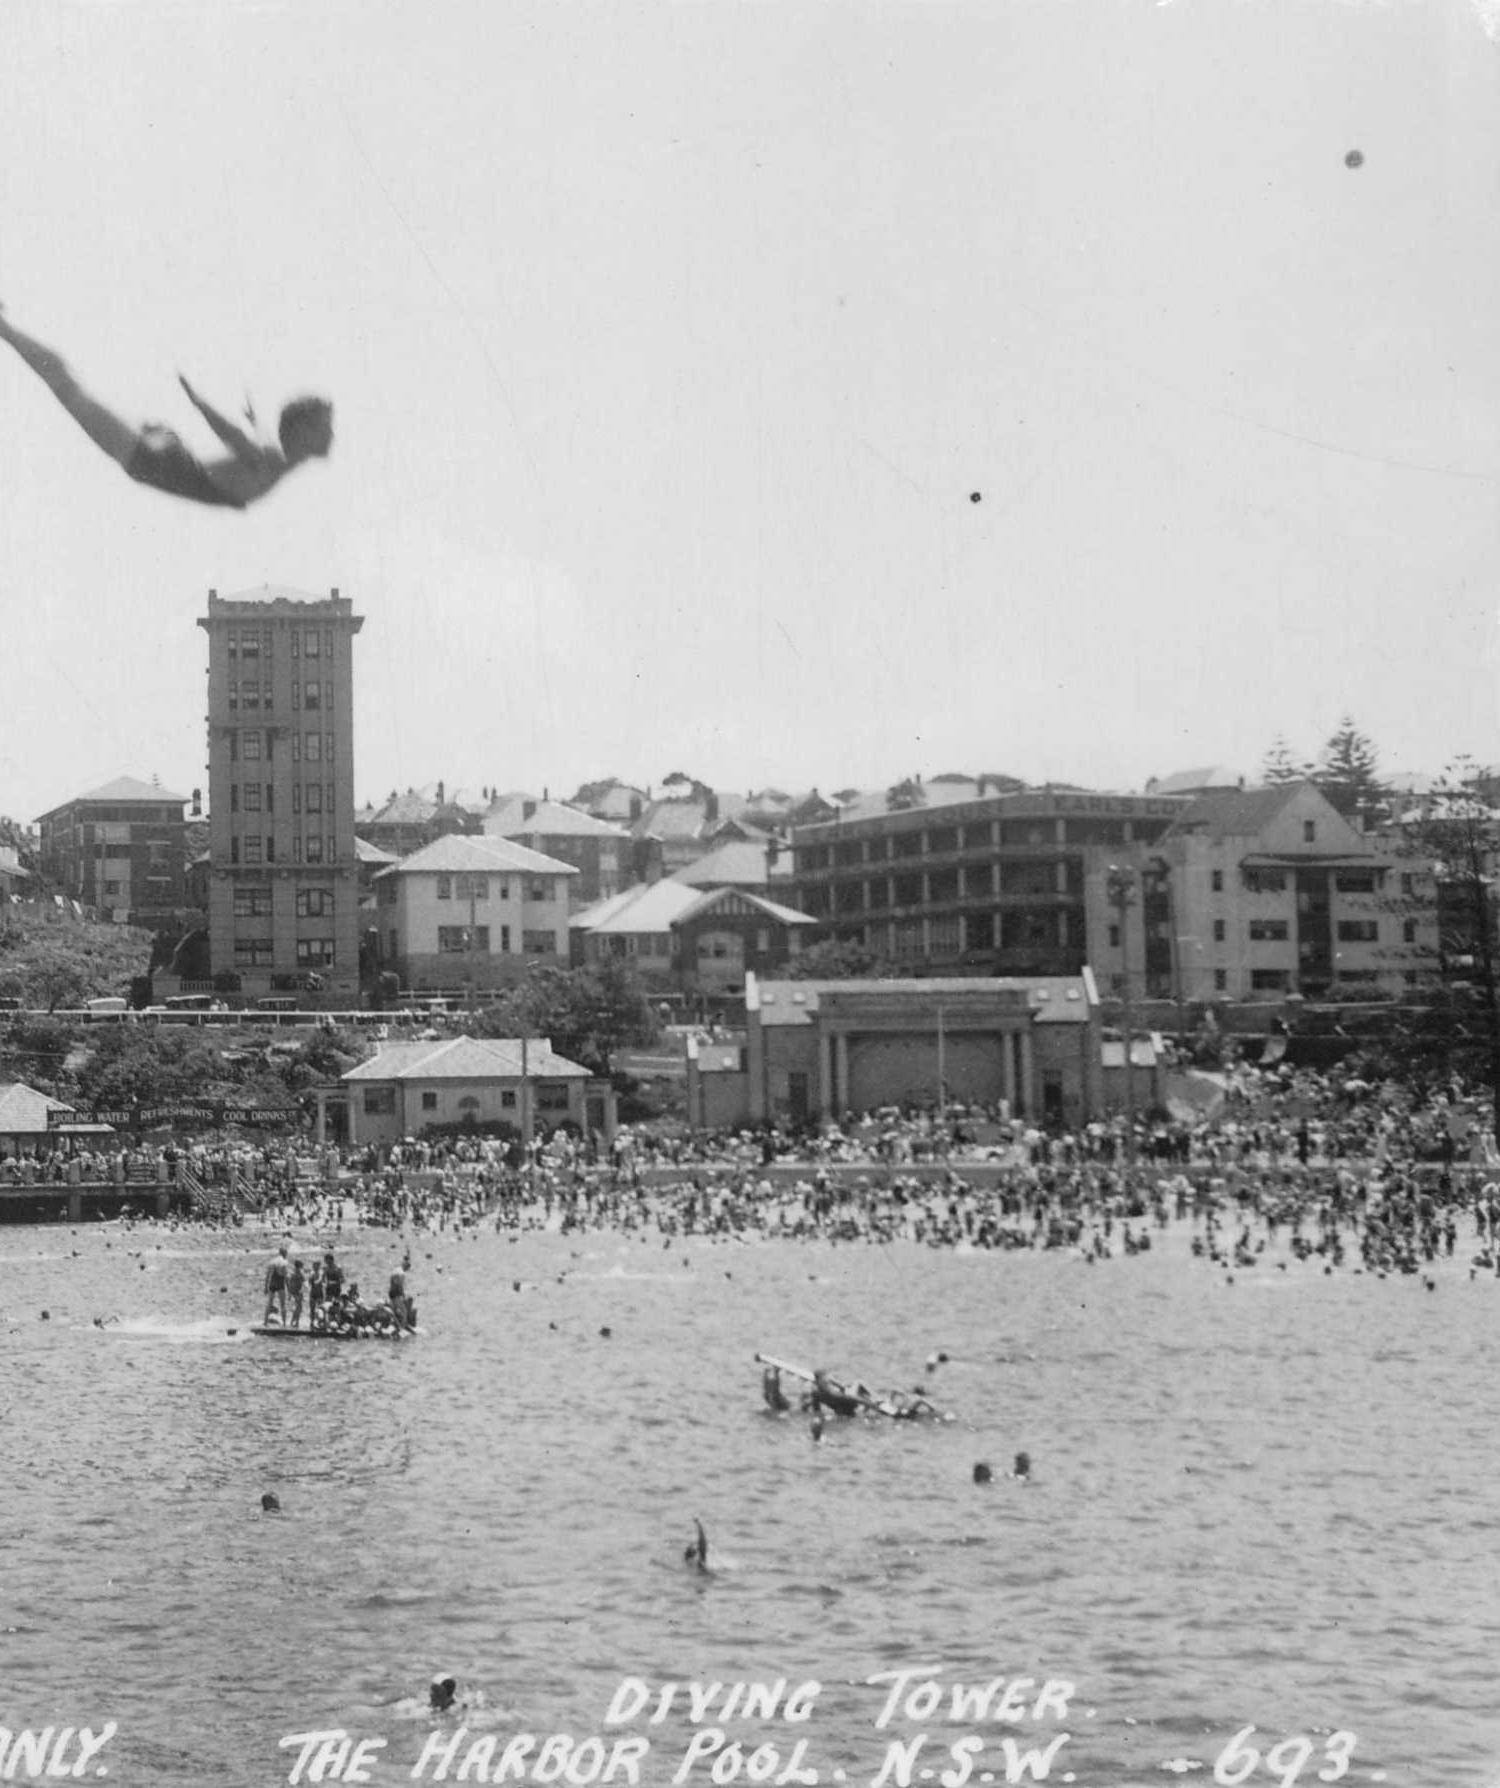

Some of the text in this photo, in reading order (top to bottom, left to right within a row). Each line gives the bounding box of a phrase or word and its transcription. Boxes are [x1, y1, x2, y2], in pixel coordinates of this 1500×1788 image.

[97, 1110, 131, 1123] WATER
[222, 1110, 248, 1121] COOL
[251, 1110, 287, 1121] DRINKS
